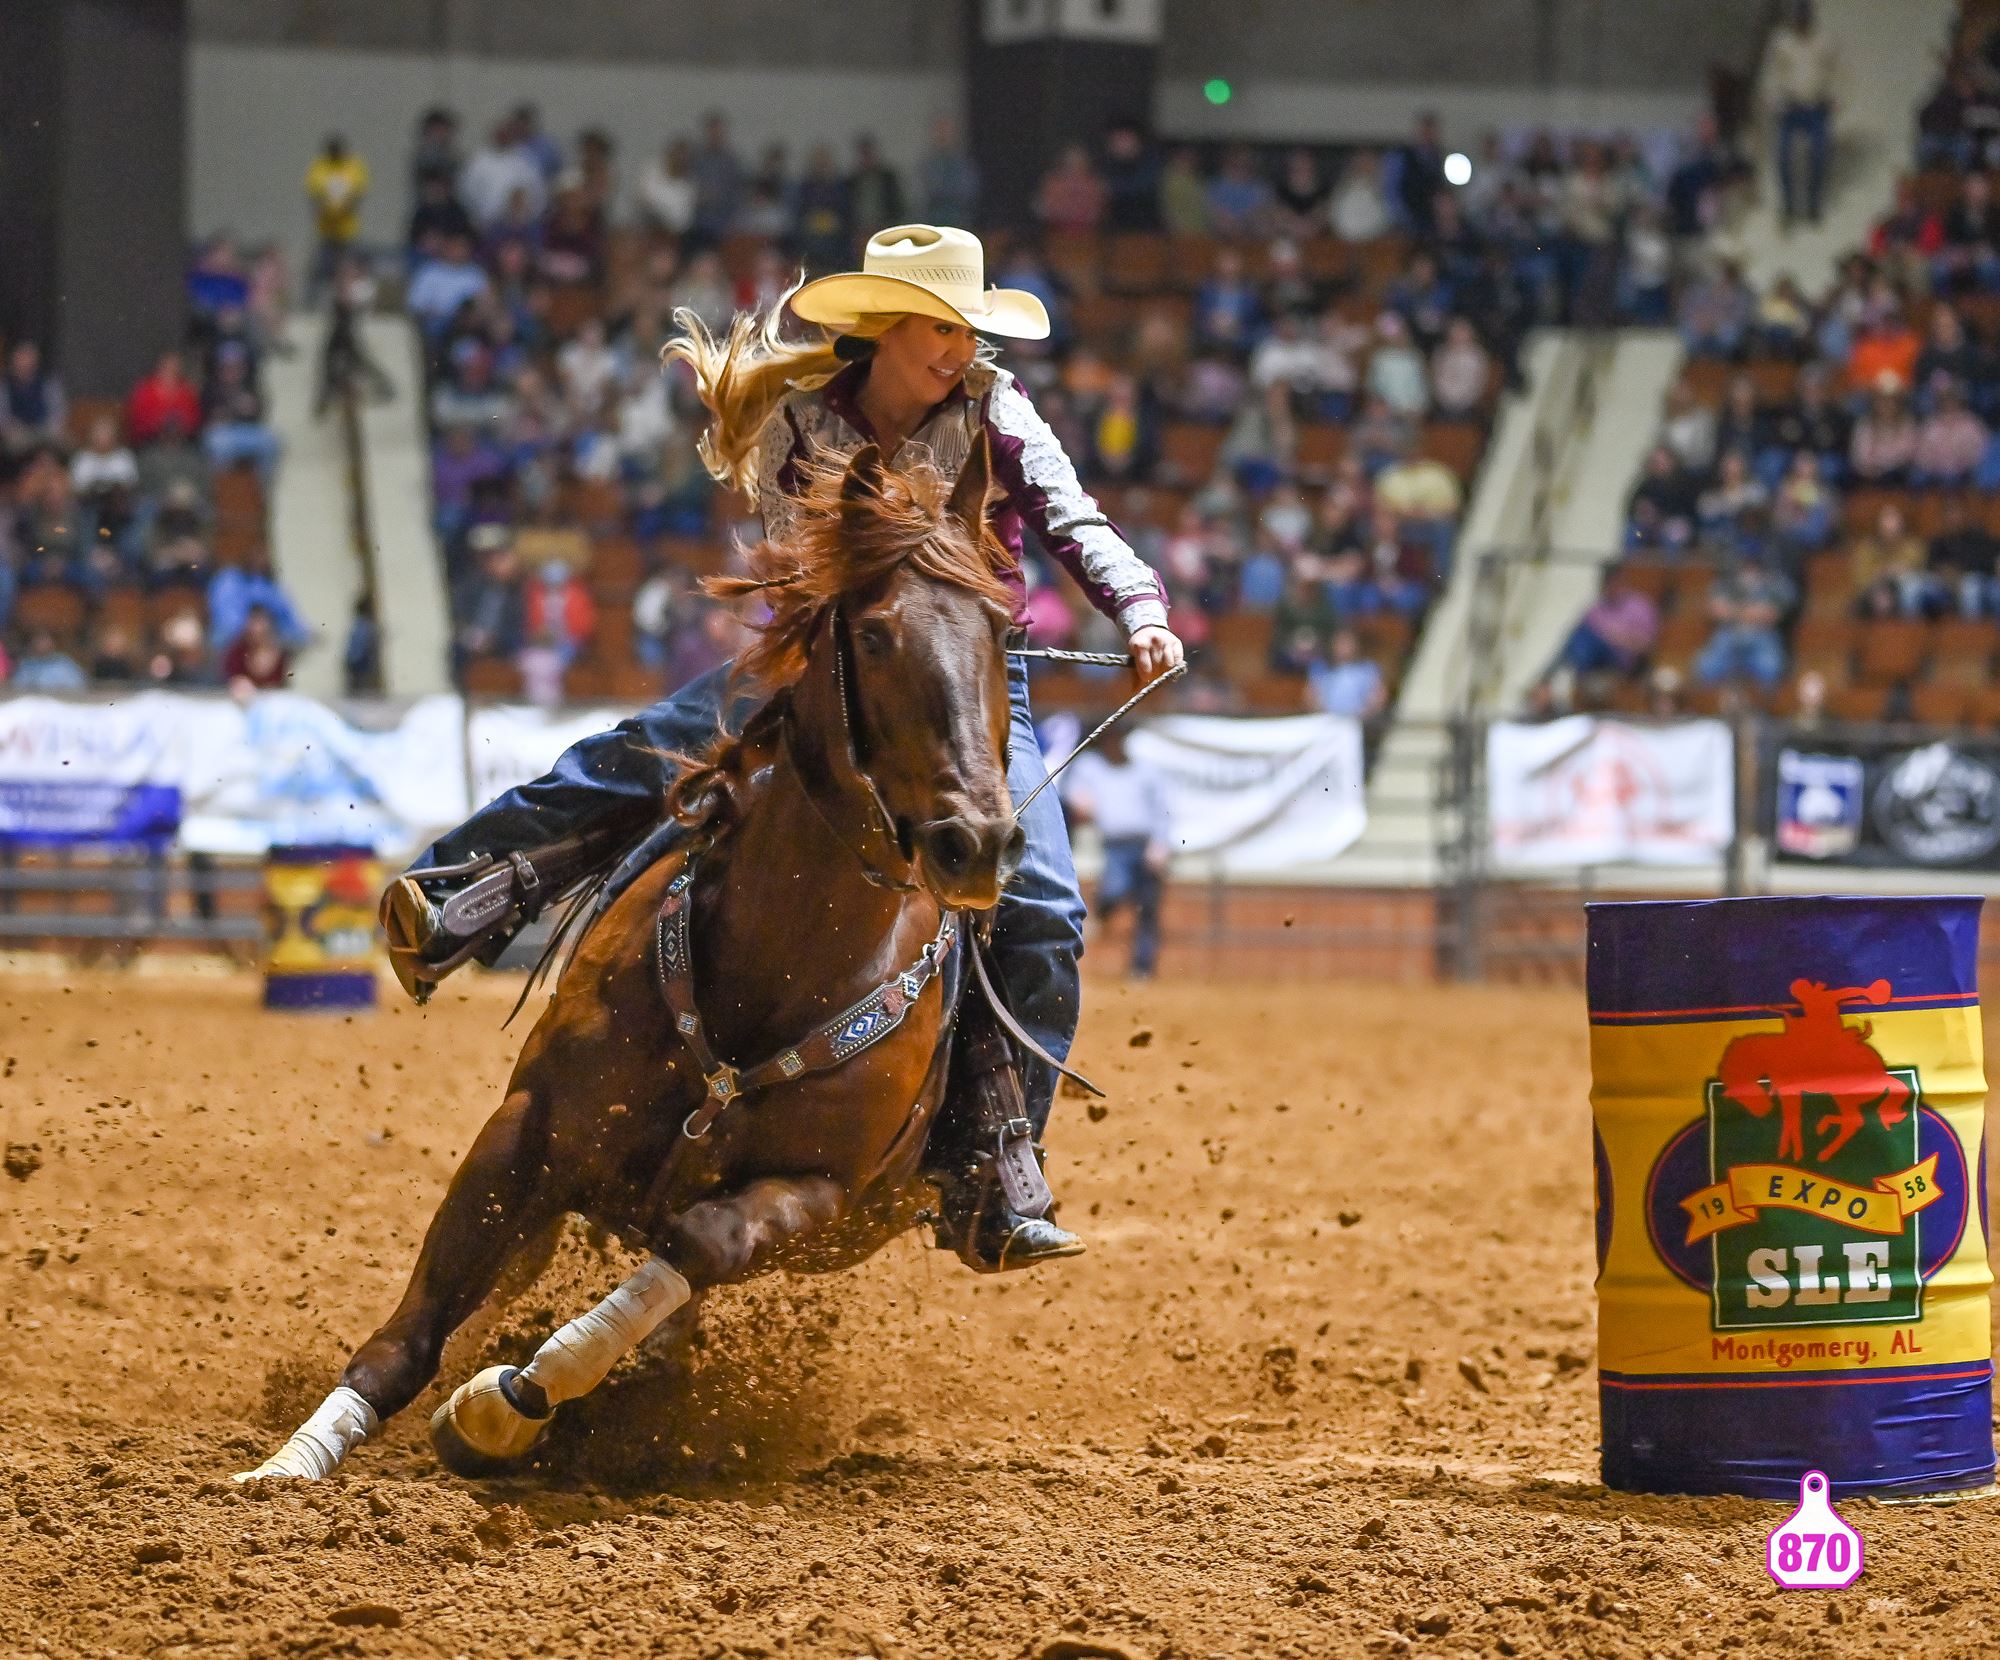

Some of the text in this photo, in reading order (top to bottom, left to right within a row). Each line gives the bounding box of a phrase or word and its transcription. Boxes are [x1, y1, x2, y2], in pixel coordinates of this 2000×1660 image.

[1699, 1175, 1927, 1220] 19 EXPO 58
[1745, 1240, 1892, 1308] SLE
[1711, 1328, 1923, 1369] Montgomery, AL
